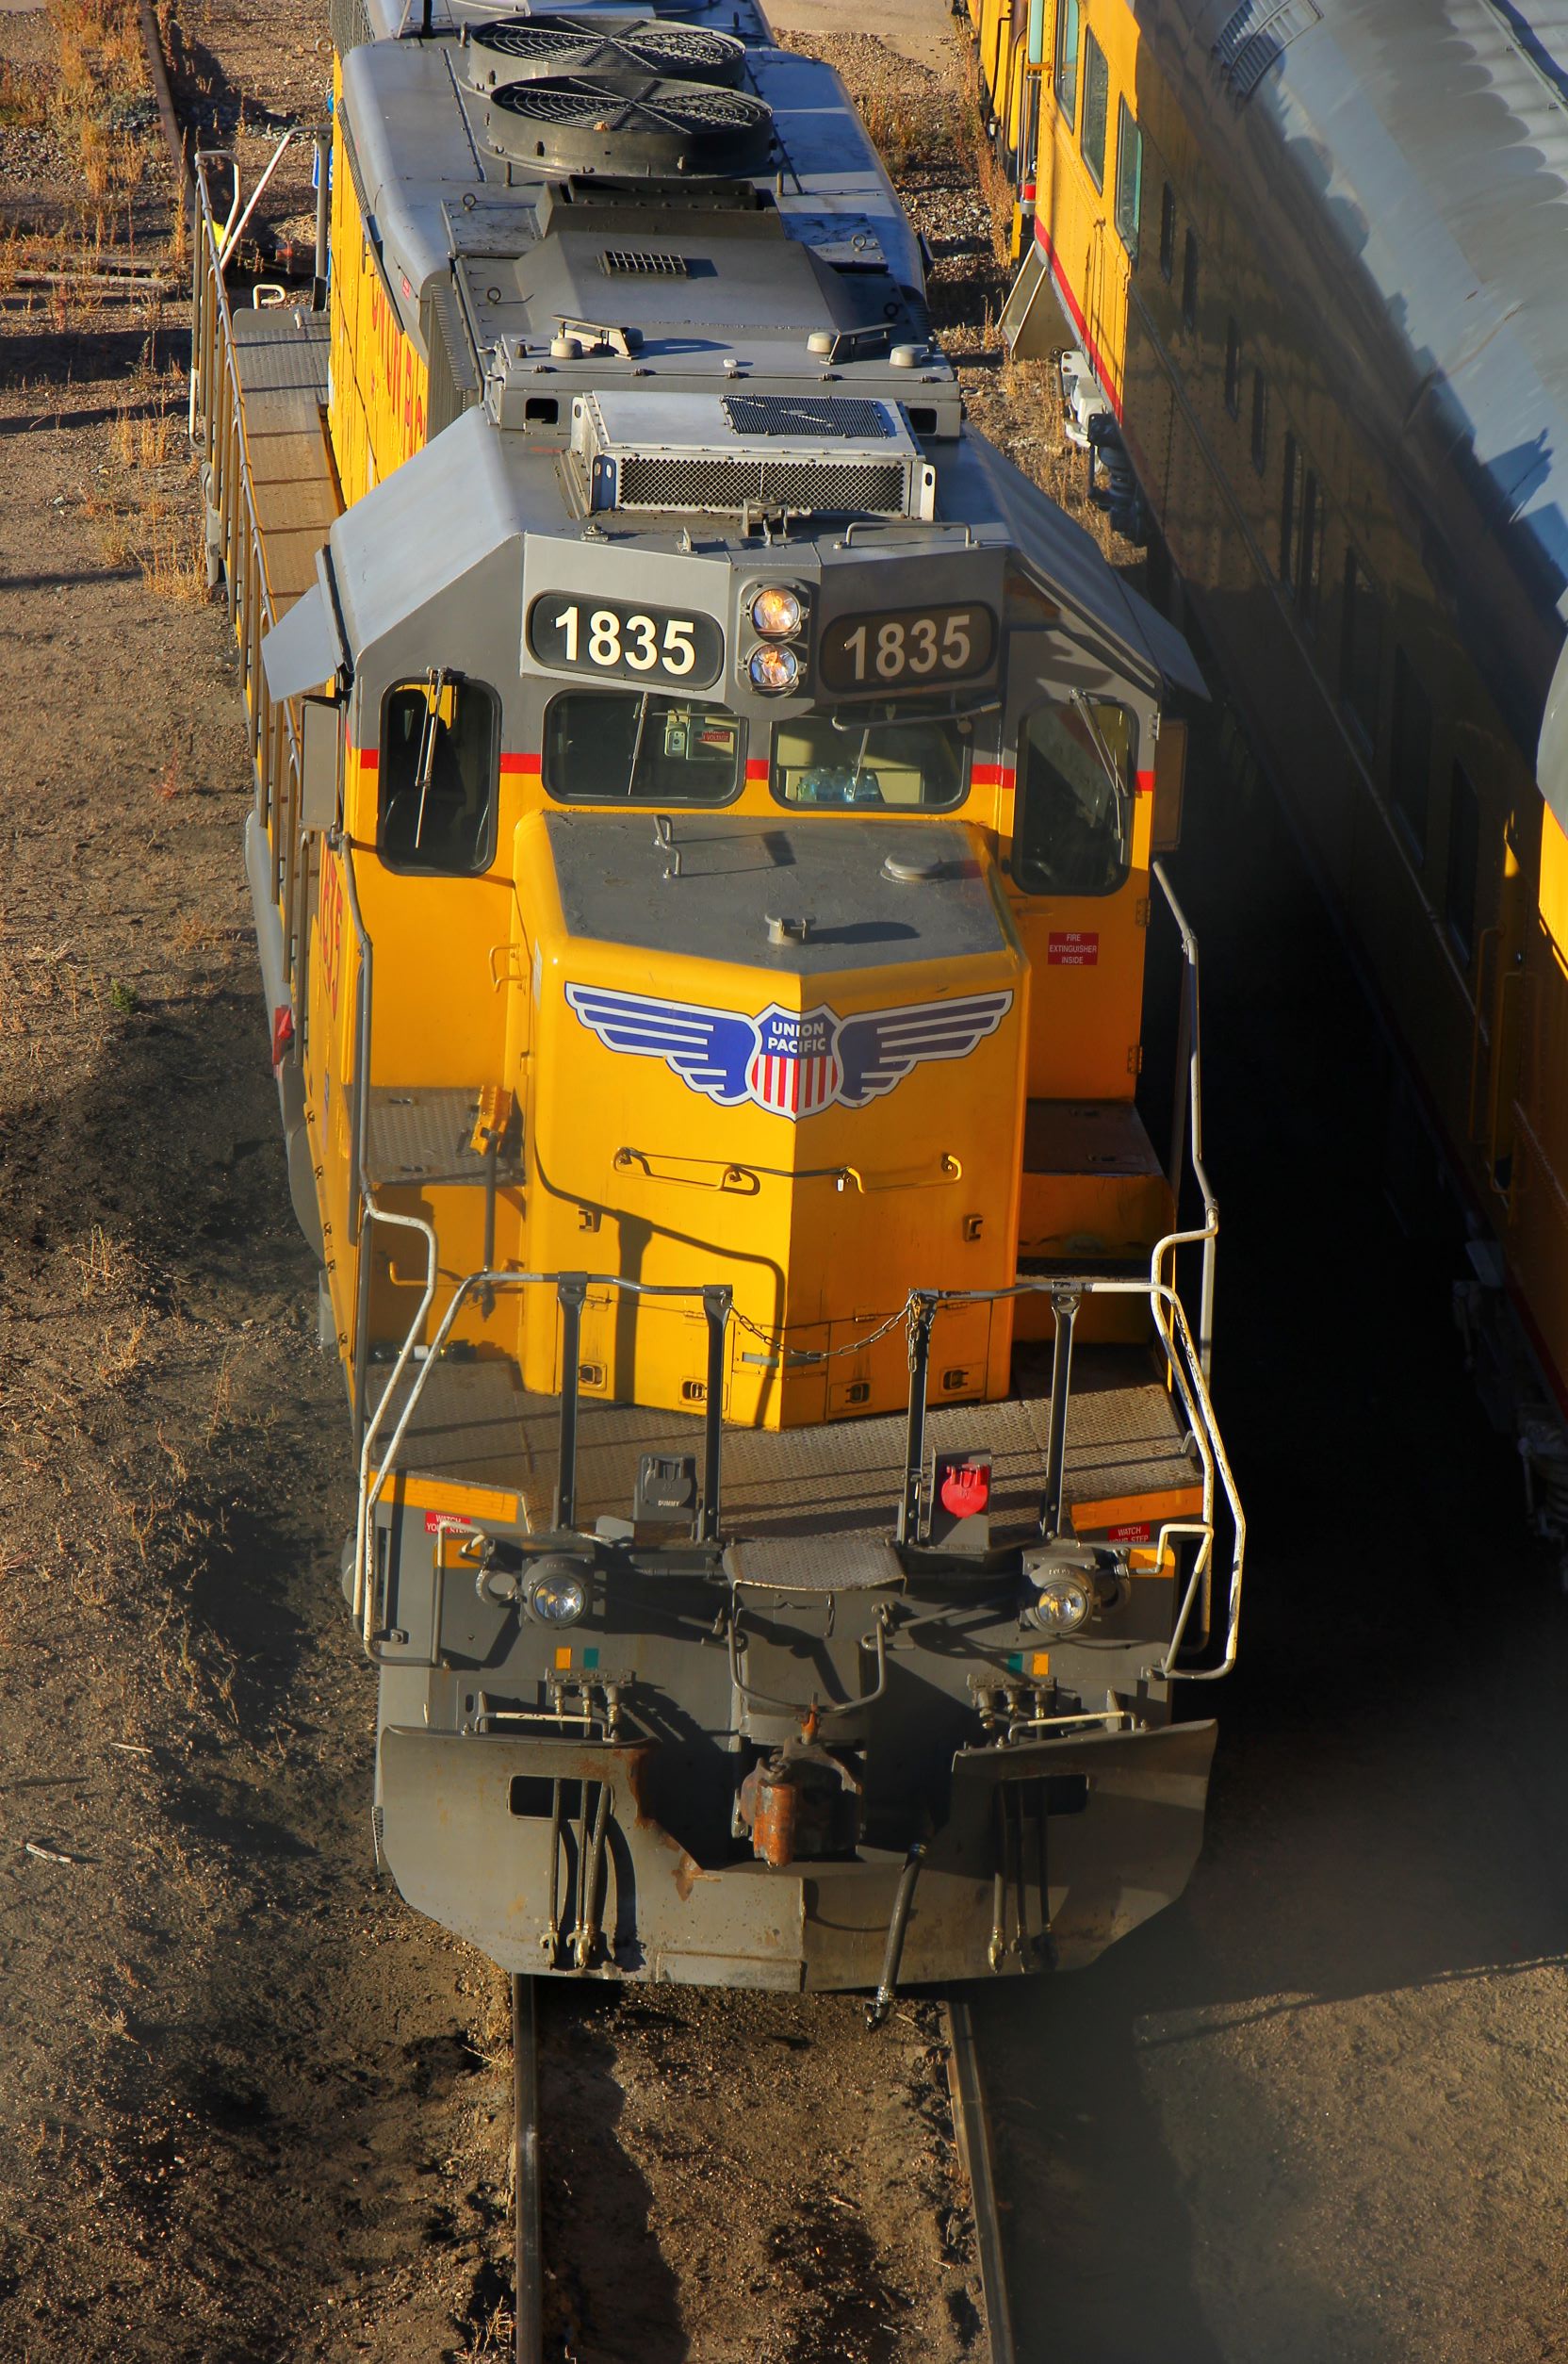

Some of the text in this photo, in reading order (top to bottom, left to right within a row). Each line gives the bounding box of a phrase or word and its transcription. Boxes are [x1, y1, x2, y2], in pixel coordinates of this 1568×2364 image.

[555, 606, 694, 675] 1835
[844, 615, 971, 681] 1835
[1066, 933, 1081, 942] FIRE
[1049, 944, 1097, 953] EXTINGUISHER
[1061, 956, 1084, 964] INSIDE
[772, 1021, 825, 1038] UNION
[767, 1037, 826, 1054] PACIFIC
[1118, 1526, 1141, 1536] WATCH
